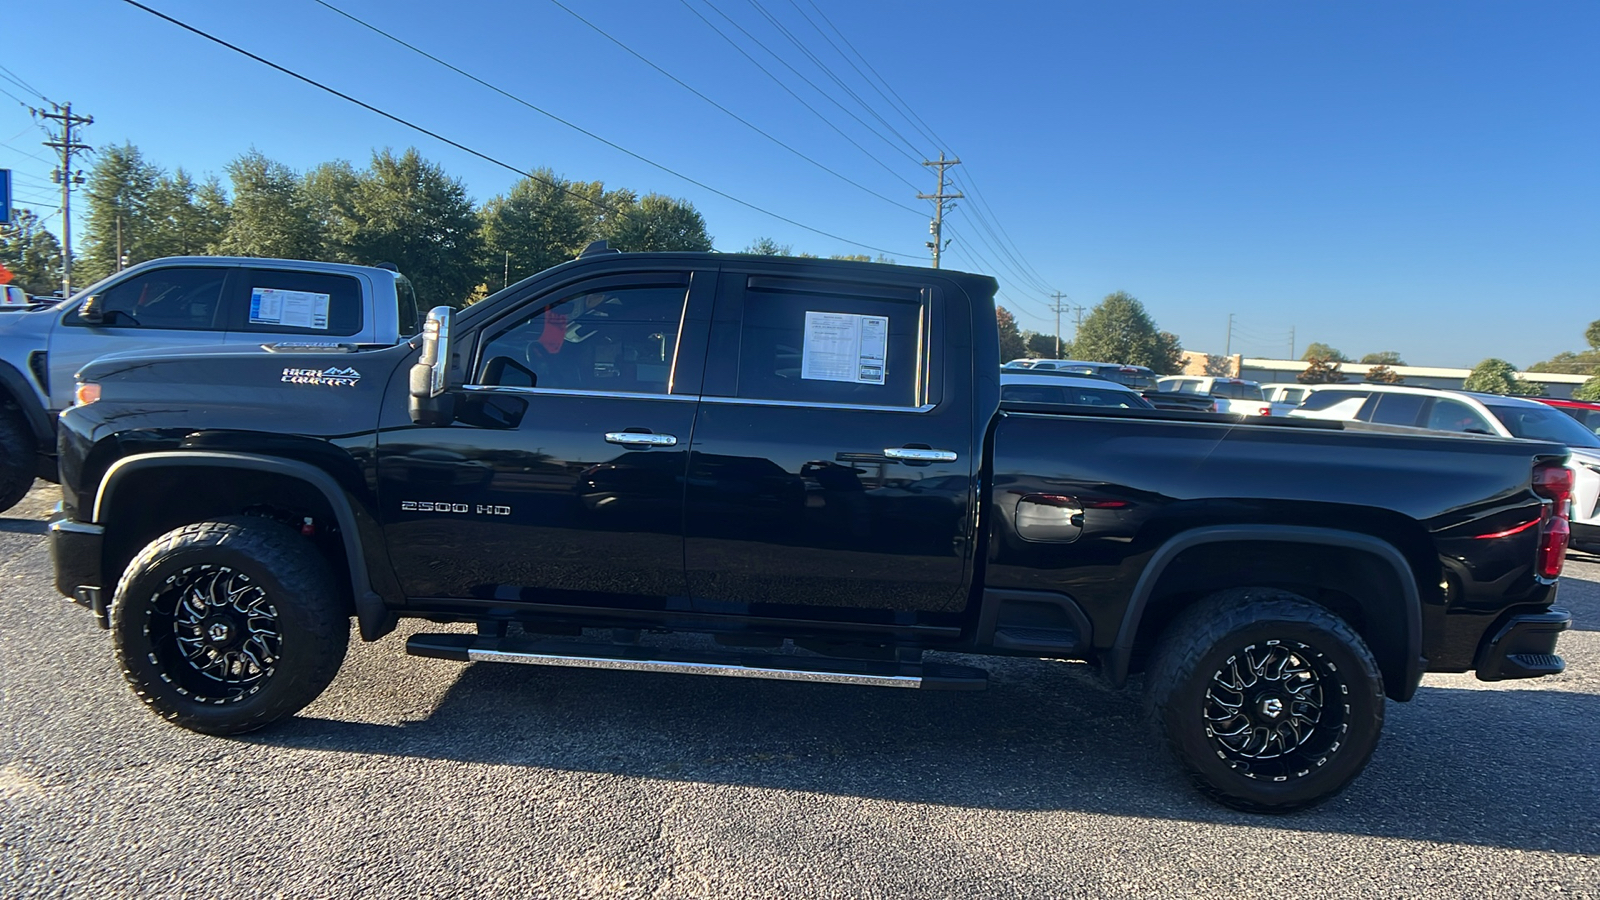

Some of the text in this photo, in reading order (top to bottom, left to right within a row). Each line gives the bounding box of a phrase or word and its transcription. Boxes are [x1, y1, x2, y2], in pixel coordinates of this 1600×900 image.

[282, 367, 323, 377] HIGH
[281, 375, 360, 387] COUNTRY
[401, 500, 511, 516] 2500 HD
